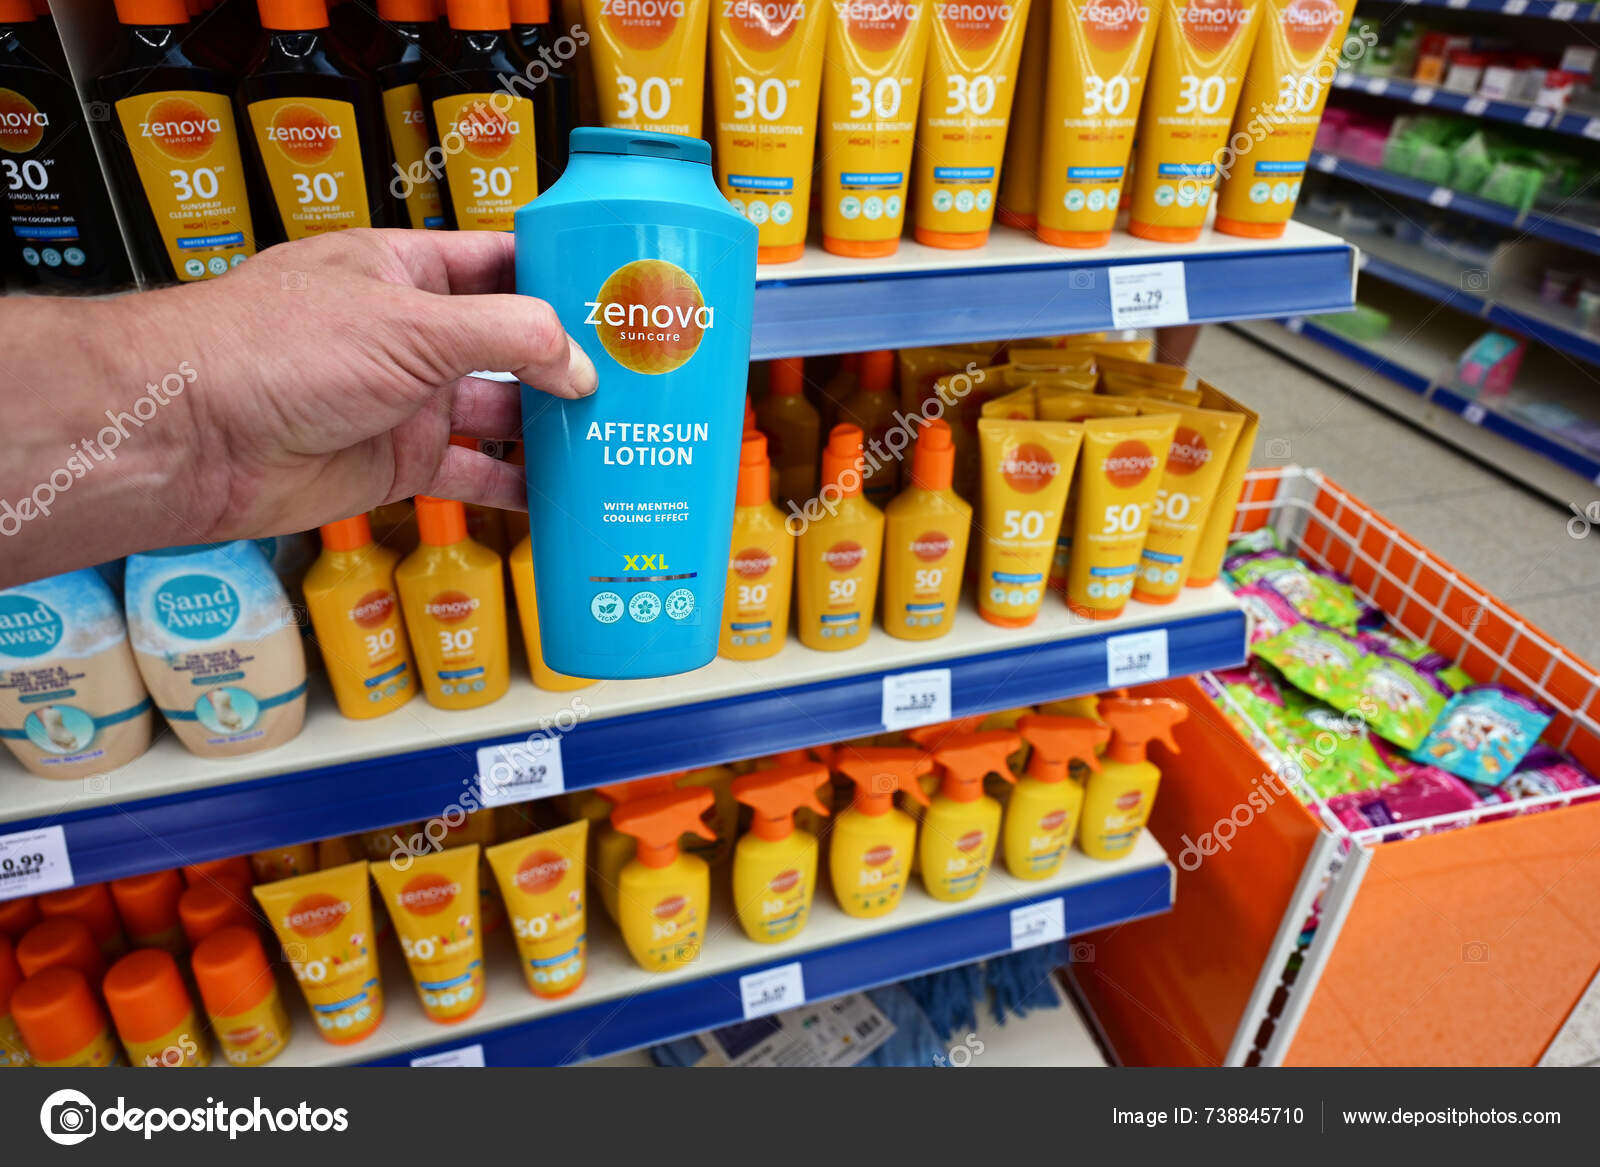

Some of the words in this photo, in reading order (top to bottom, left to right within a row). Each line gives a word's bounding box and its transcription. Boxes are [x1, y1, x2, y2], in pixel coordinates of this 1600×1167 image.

[601, 0, 684, 17] zenova
[722, 1, 805, 20] zenova
[838, 2, 919, 21] zenova
[937, 4, 1014, 21] zenova
[1078, 4, 1150, 22] zenova
[1177, 6, 1252, 24] zenova
[1279, 7, 1344, 25] zenova
[616, 75, 671, 120] 30
[734, 77, 787, 120] 30
[849, 76, 901, 118] 30
[944, 74, 996, 115] 30
[1082, 75, 1130, 115] 30
[1176, 75, 1226, 114] 30
[1274, 74, 1321, 113] 30
[0, 112, 49, 127] nova
[139, 118, 221, 137] zenova
[449, 120, 521, 137] zenova
[164, 136, 202, 144] suncare
[266, 125, 342, 141] zenova
[2, 159, 48, 190] 30
[469, 166, 512, 197] 30
[169, 168, 219, 201] 30
[292, 172, 338, 204] 30
[169, 210, 193, 219] CLEAR
[203, 206, 236, 217] PROTECT
[180, 201, 222, 211] SUNSPRAY
[292, 213, 314, 221] CLEAR
[323, 210, 355, 220] PROTECT
[1133, 287, 1162, 305] 4.79
[584, 301, 714, 329] zenova
[620, 331, 680, 342] suncare
[586, 422, 708, 442] AFTERSUN
[604, 446, 693, 466] LOTION
[1101, 455, 1158, 473] zenova
[997, 457, 1060, 476] zenova
[603, 502, 634, 511] WITH
[637, 501, 689, 511] MENTHOL
[603, 514, 652, 523] COOLING
[655, 513, 689, 522] EFFECT
[1002, 510, 1045, 539] 50
[1103, 503, 1142, 534] 50
[623, 554, 670, 571] XXL
[915, 569, 943, 588] 50
[157, 584, 232, 612] Sand
[597, 593, 619, 602] VEGAN
[738, 584, 767, 605] 30
[829, 578, 857, 600] 50
[0, 602, 53, 627] and
[166, 604, 236, 629] Away
[597, 613, 618, 622] VEGAN
[365, 628, 396, 657] 30
[440, 629, 473, 651] 30
